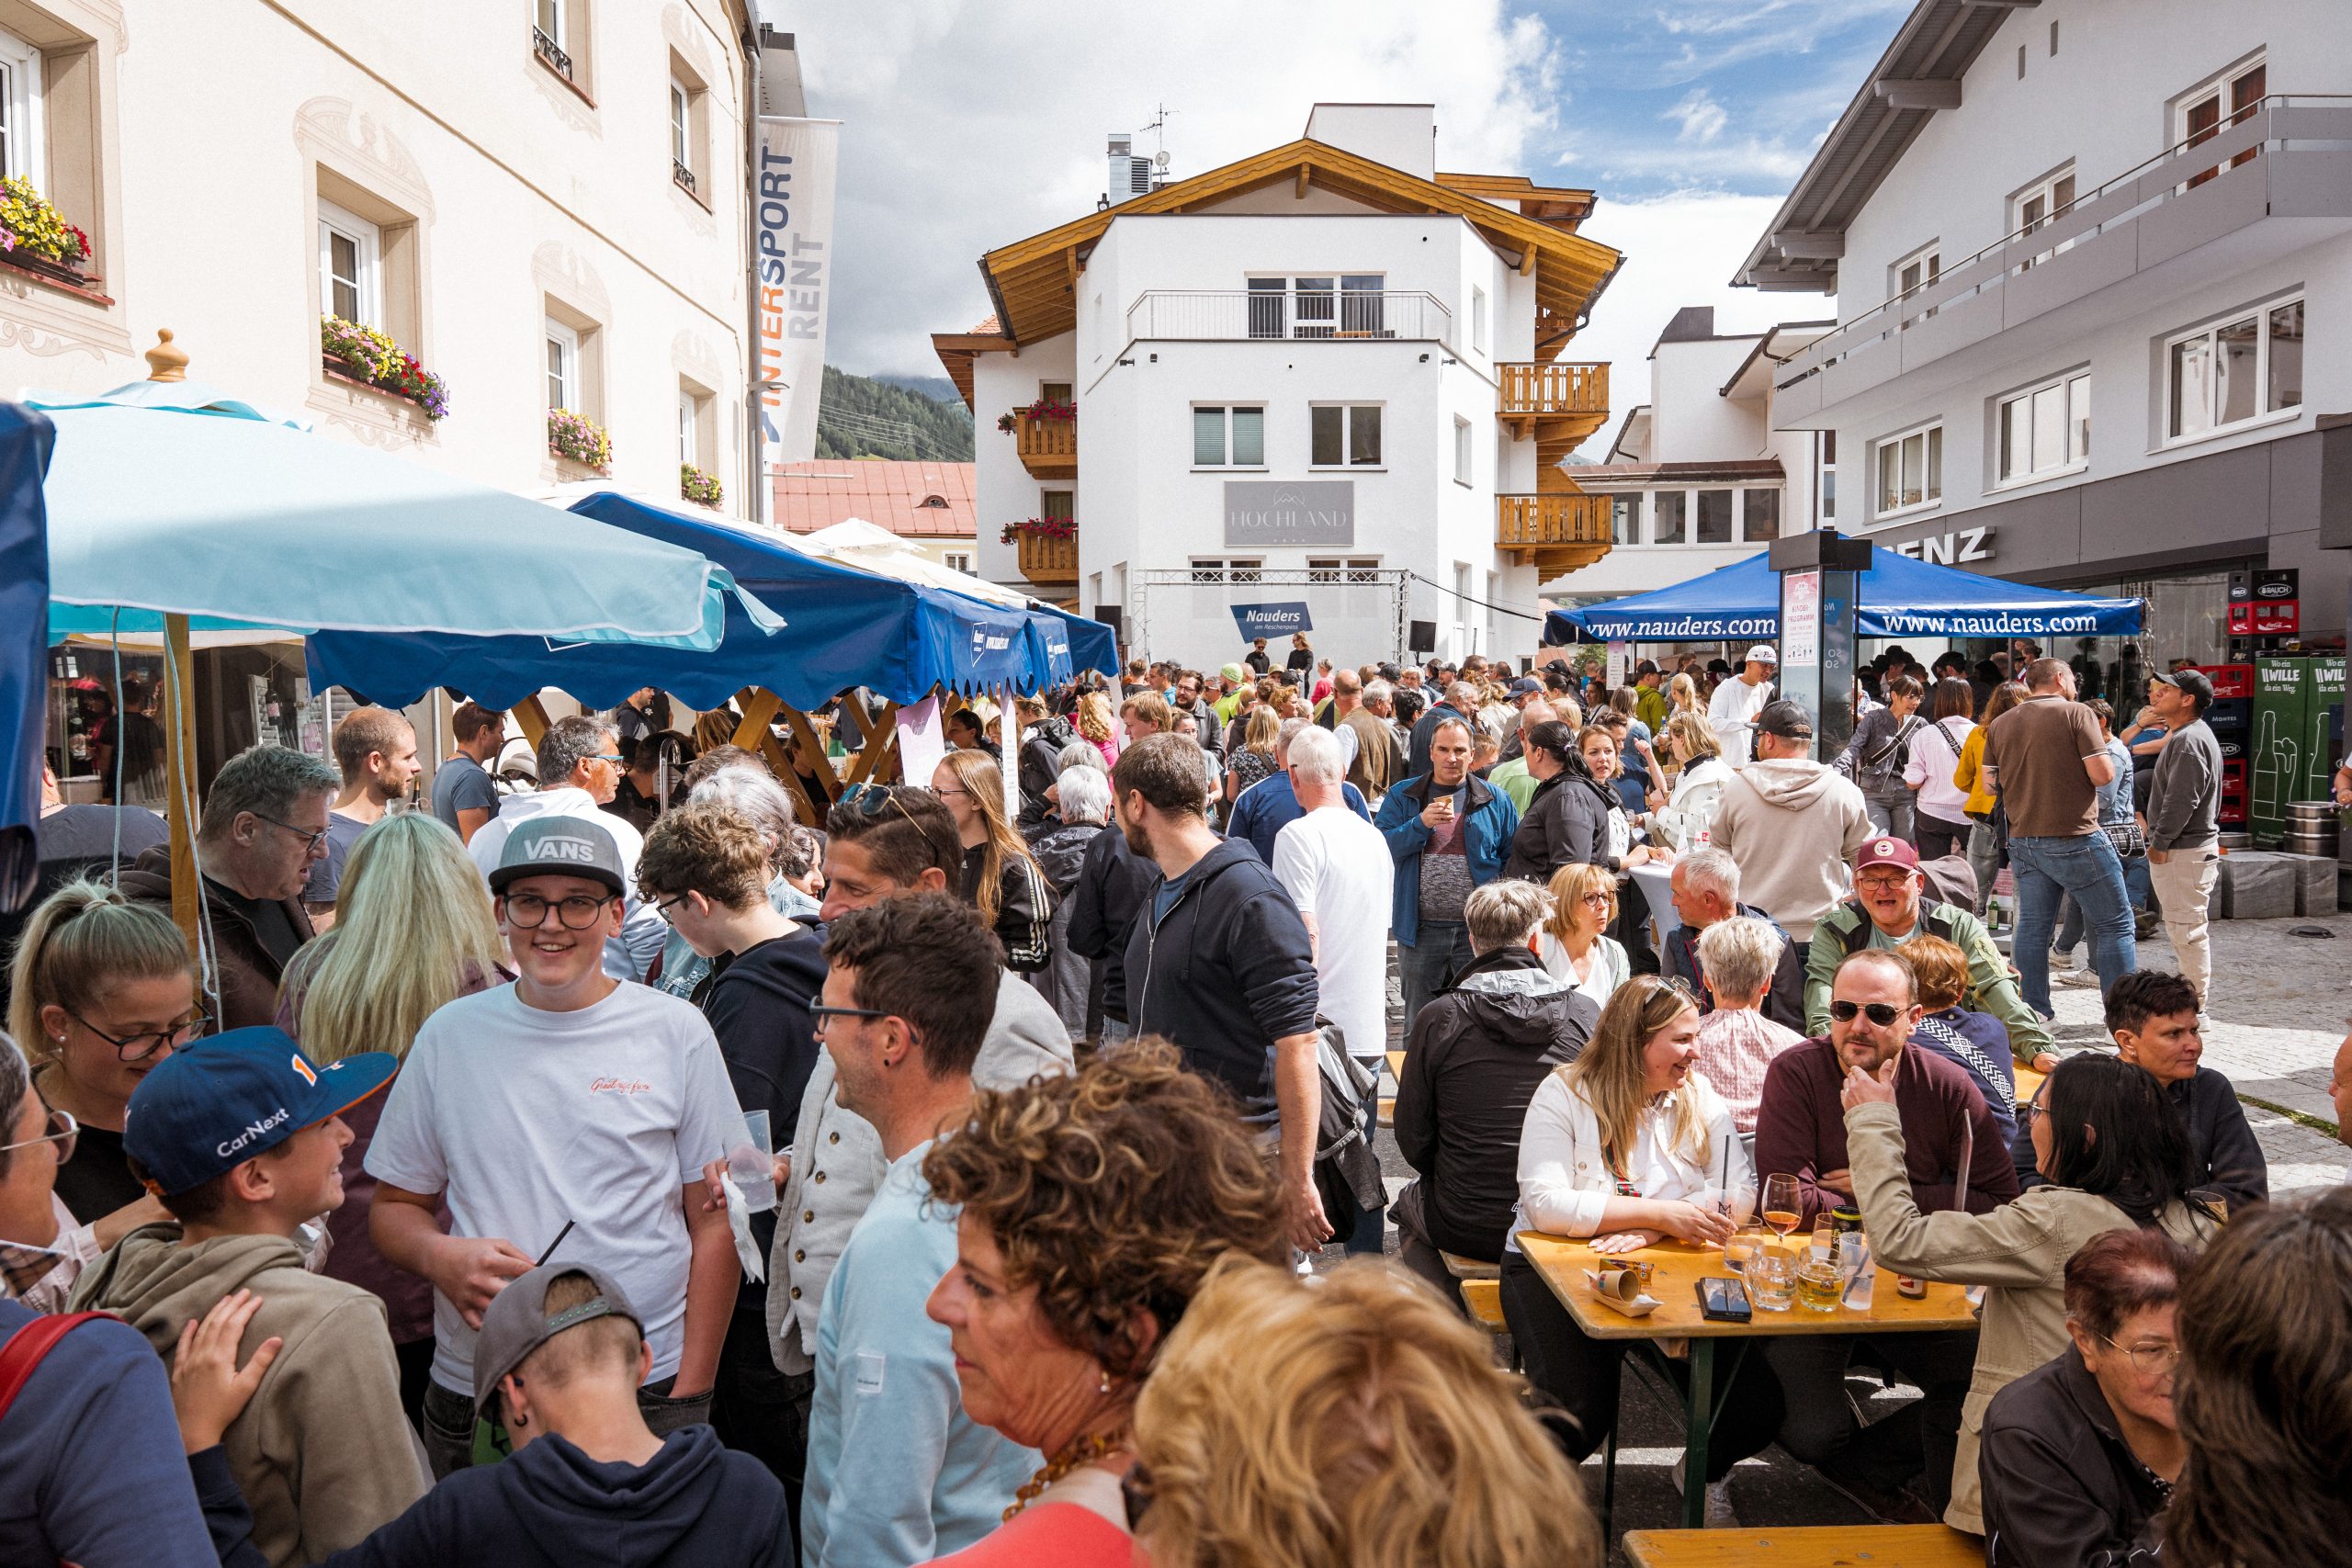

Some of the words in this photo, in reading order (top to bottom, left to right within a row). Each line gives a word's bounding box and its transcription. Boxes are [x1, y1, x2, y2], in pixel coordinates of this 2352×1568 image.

[788, 232, 823, 340] RENT
[1231, 511, 1346, 527] HOCHLAND
[1882, 525, 1988, 565] ENZ
[1246, 610, 1301, 622] Nauders
[1883, 612, 2098, 633] www.nauders.com
[524, 835, 595, 863] VANS
[216, 1108, 289, 1157] CarNext
